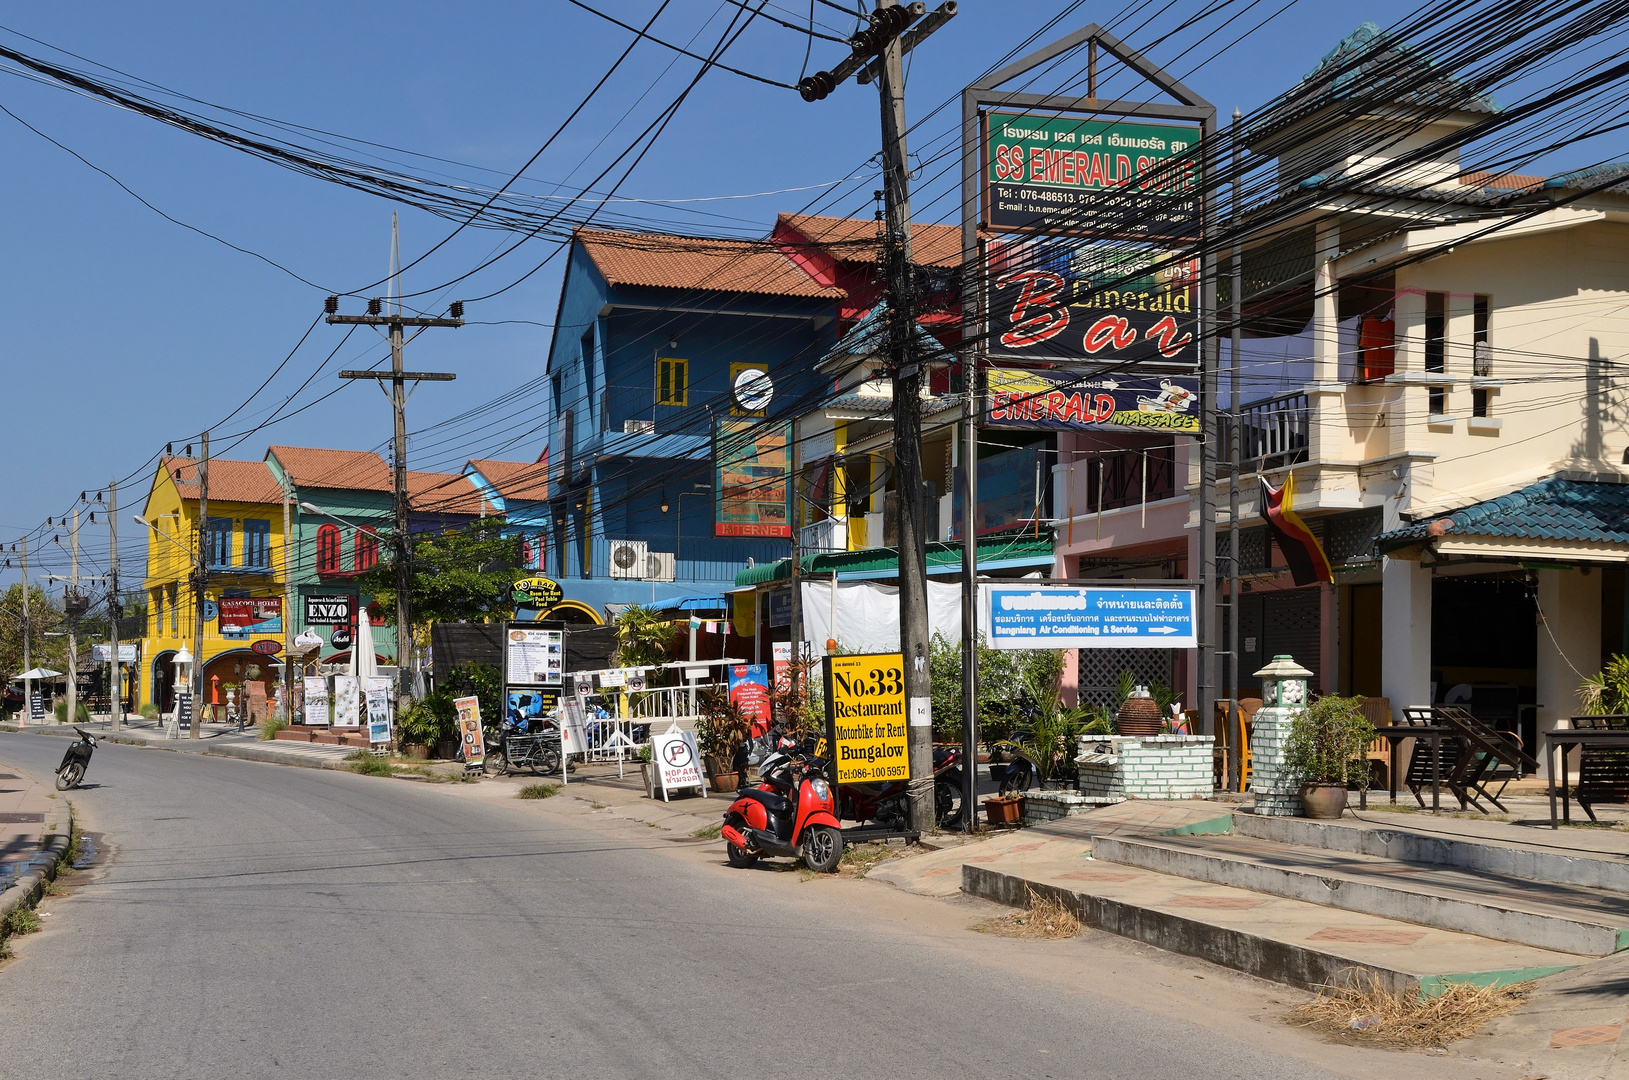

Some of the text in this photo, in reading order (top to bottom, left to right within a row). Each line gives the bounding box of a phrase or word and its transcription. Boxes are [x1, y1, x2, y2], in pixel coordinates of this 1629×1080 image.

[1003, 123, 1048, 141] โรงแรม
[1054, 131, 1076, 143] เอส
[1081, 133, 1102, 145] เอส
[995, 144, 1025, 180] SS
[1029, 147, 1132, 188] EMERALD
[998, 188, 1012, 198] Tel
[999, 202, 1022, 211] E-mail
[1070, 279, 1191, 314] Emerald
[995, 269, 1192, 358] Bar
[991, 390, 1116, 423] EMERALD
[1112, 412, 1195, 428] MASSAGE
[721, 524, 786, 536] INTERNET
[1096, 593, 1183, 609] จำหน่ายและติดตั้ง
[308, 604, 347, 617] ENZO
[995, 611, 1034, 623] ซ่อมบริการ
[1039, 611, 1099, 623] เครื่องปรับอากาศ
[995, 625, 1138, 636] Bangniang Air Conditioning & Service
[833, 668, 903, 698] No.33
[835, 699, 903, 718] Restaurant
[835, 723, 906, 741] Motorbike for Rent
[840, 742, 904, 763] Bungalow
[887, 766, 906, 777] 5957
